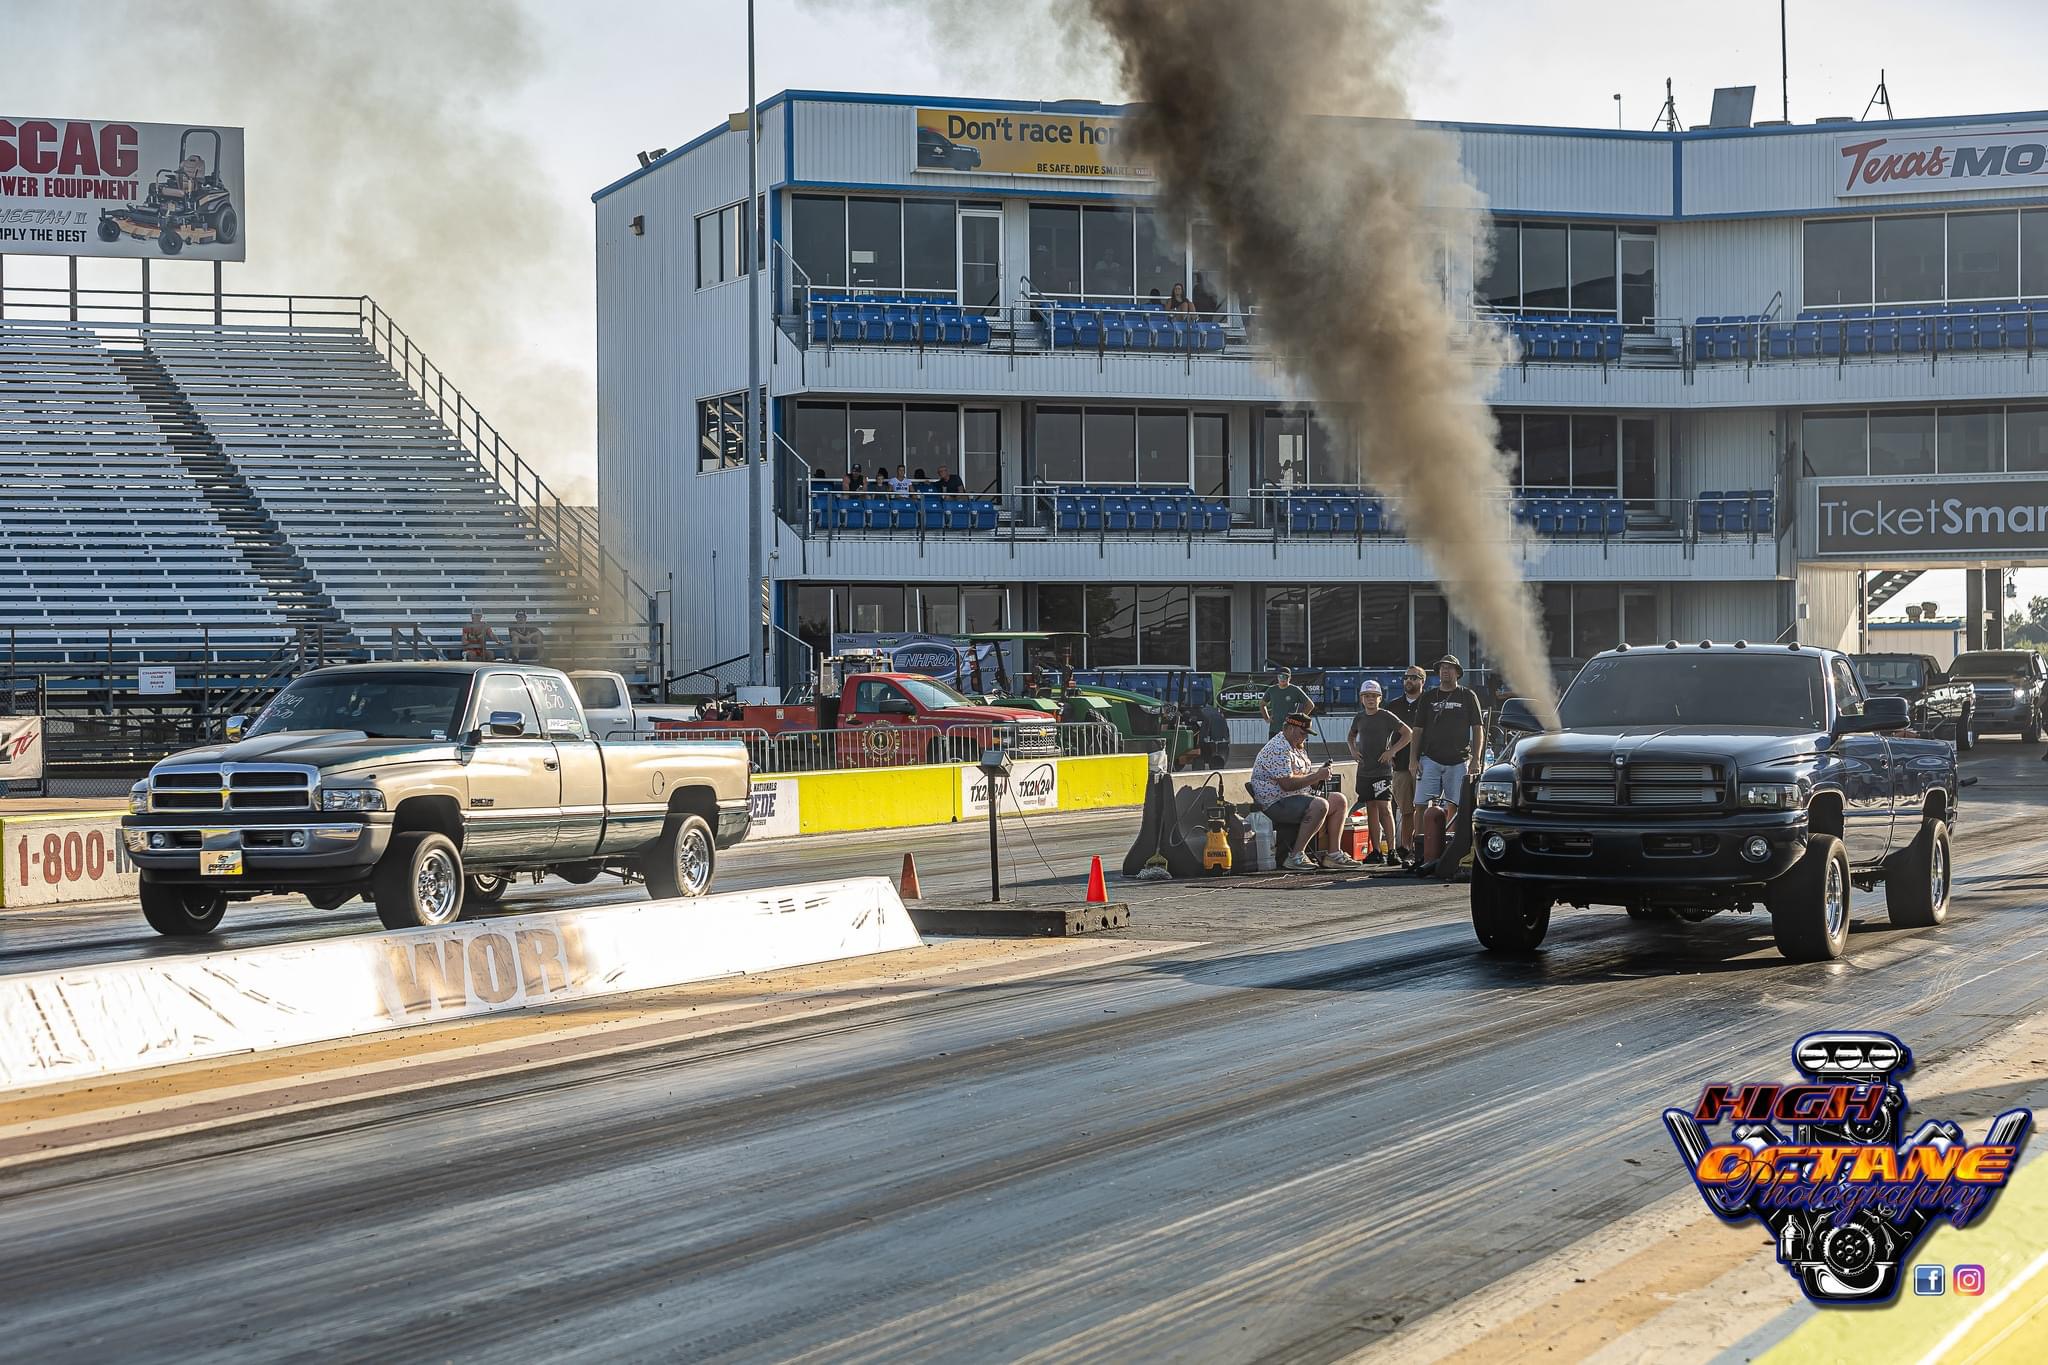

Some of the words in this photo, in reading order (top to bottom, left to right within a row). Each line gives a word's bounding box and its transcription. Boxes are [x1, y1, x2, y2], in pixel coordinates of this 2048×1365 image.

[947, 115, 1013, 142] Don't
[1019, 123, 1073, 143] race
[1079, 120, 1120, 145] ho
[1037, 163, 1048, 172] BE
[1049, 164, 1073, 173] SAFE.
[1075, 165, 1099, 174] DRIVE
[1841, 138, 1950, 191] Texas
[0, 175, 38, 197] WER
[44, 177, 139, 200] EQUIPMENT
[30, 229, 53, 241] THE
[56, 230, 87, 242] BEST
[1820, 498, 2048, 536] TicketSmar
[904, 653, 956, 668] NHRDA
[1220, 693, 1242, 701] HOT
[970, 784, 1003, 802] TX224
[1019, 779, 1051, 798] TX2K24
